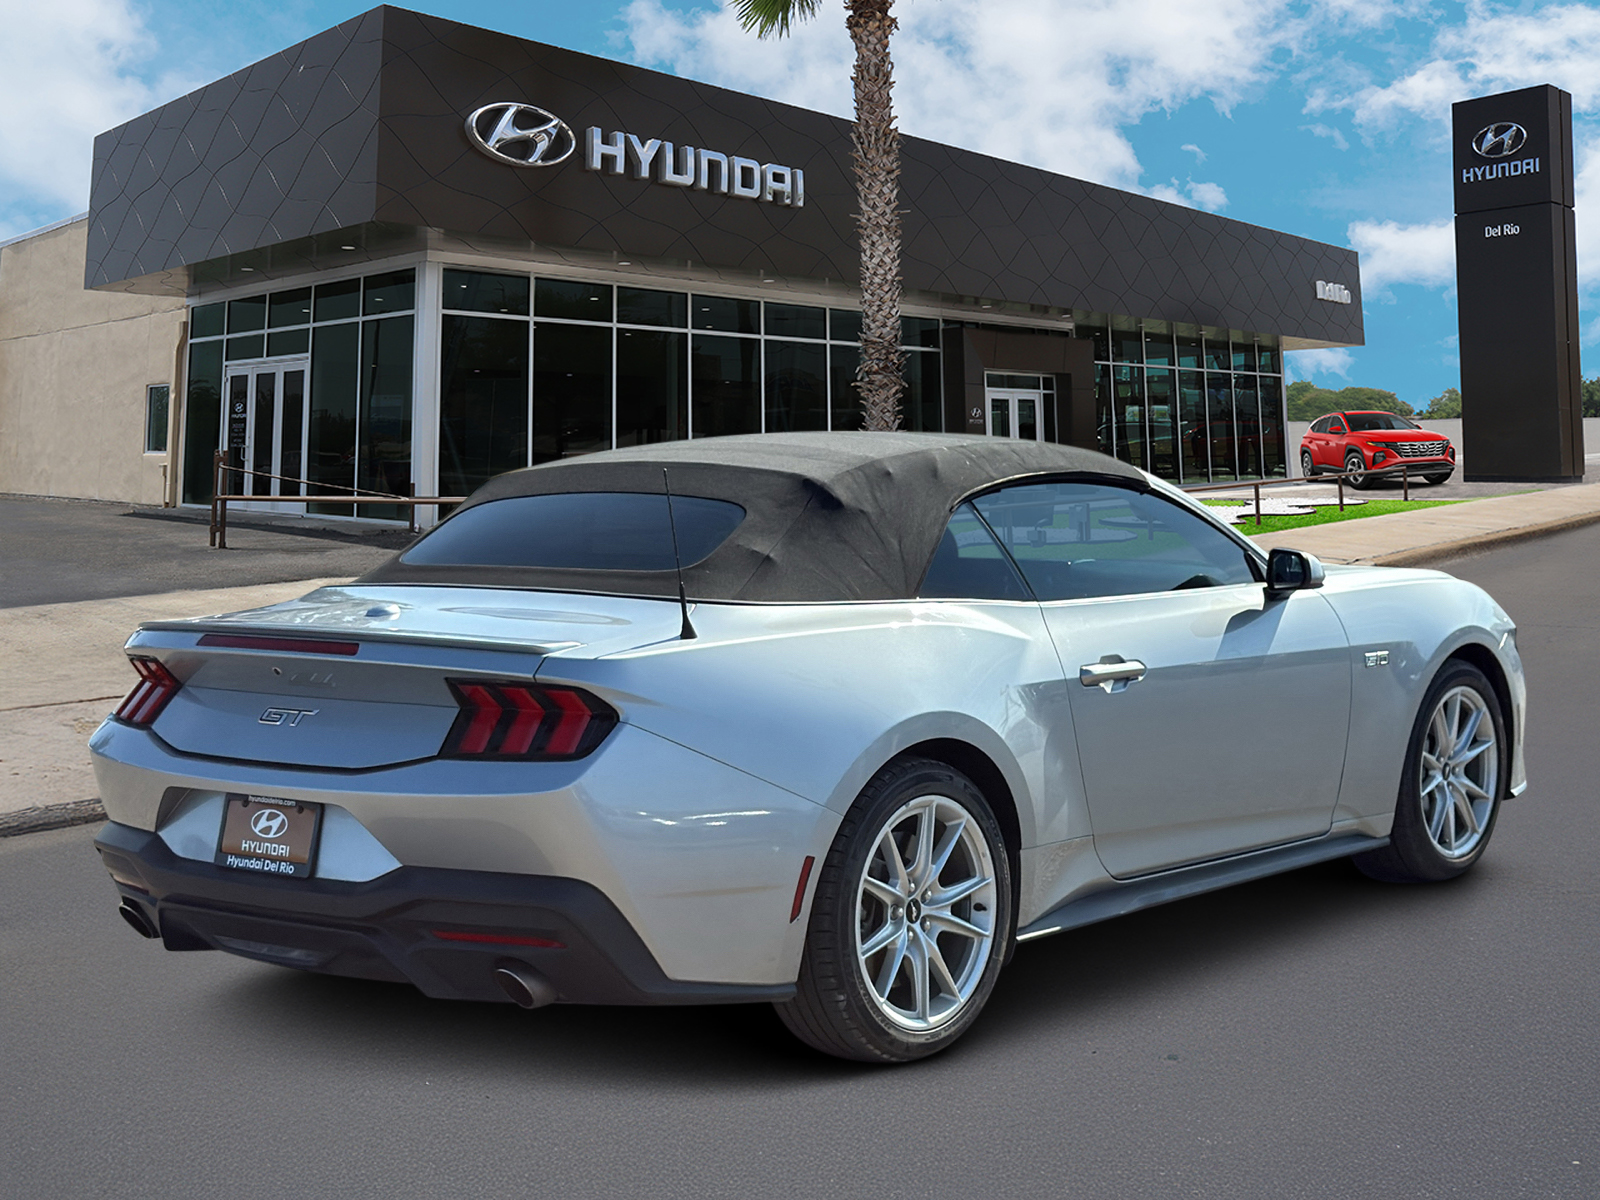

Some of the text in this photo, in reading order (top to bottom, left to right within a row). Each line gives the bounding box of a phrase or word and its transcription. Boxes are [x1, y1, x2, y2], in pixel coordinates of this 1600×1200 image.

[586, 126, 804, 207] HYUNDAI
[1462, 157, 1540, 183] HYUNDAI
[1484, 223, 1520, 238] Del Rio
[258, 706, 320, 727] GT
[241, 840, 289, 857] HYUNDAI
[226, 855, 295, 874] Hyundai Del Rio
